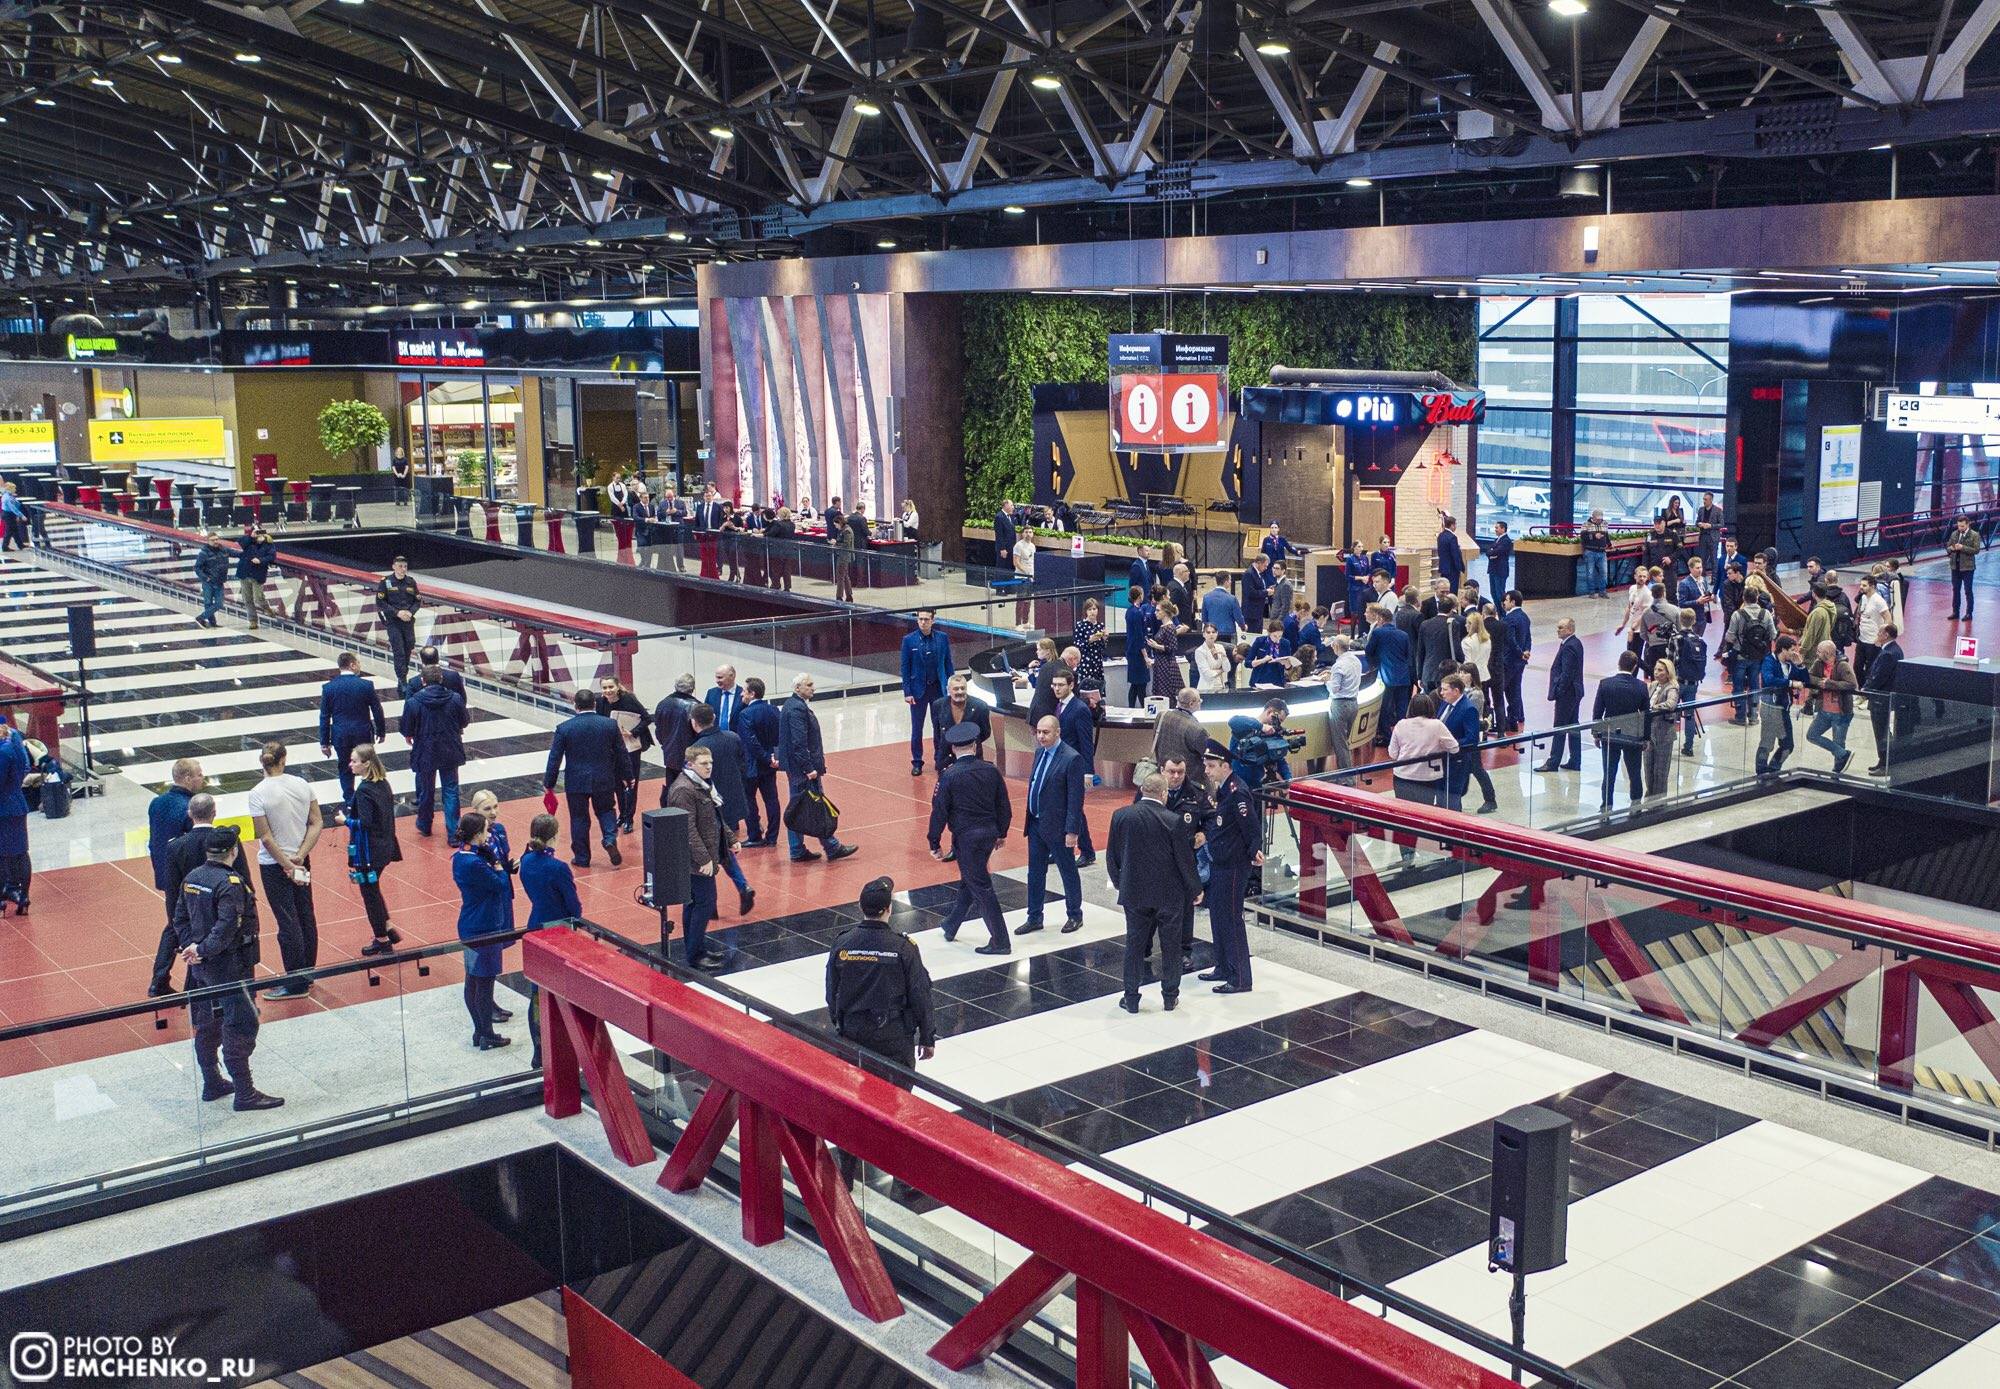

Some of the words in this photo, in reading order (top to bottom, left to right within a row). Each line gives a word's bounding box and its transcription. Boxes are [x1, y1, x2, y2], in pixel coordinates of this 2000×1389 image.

[1175, 344, 1215, 354] Информация
[1357, 396, 1394, 421] Più
[1421, 393, 1477, 424] Bud
